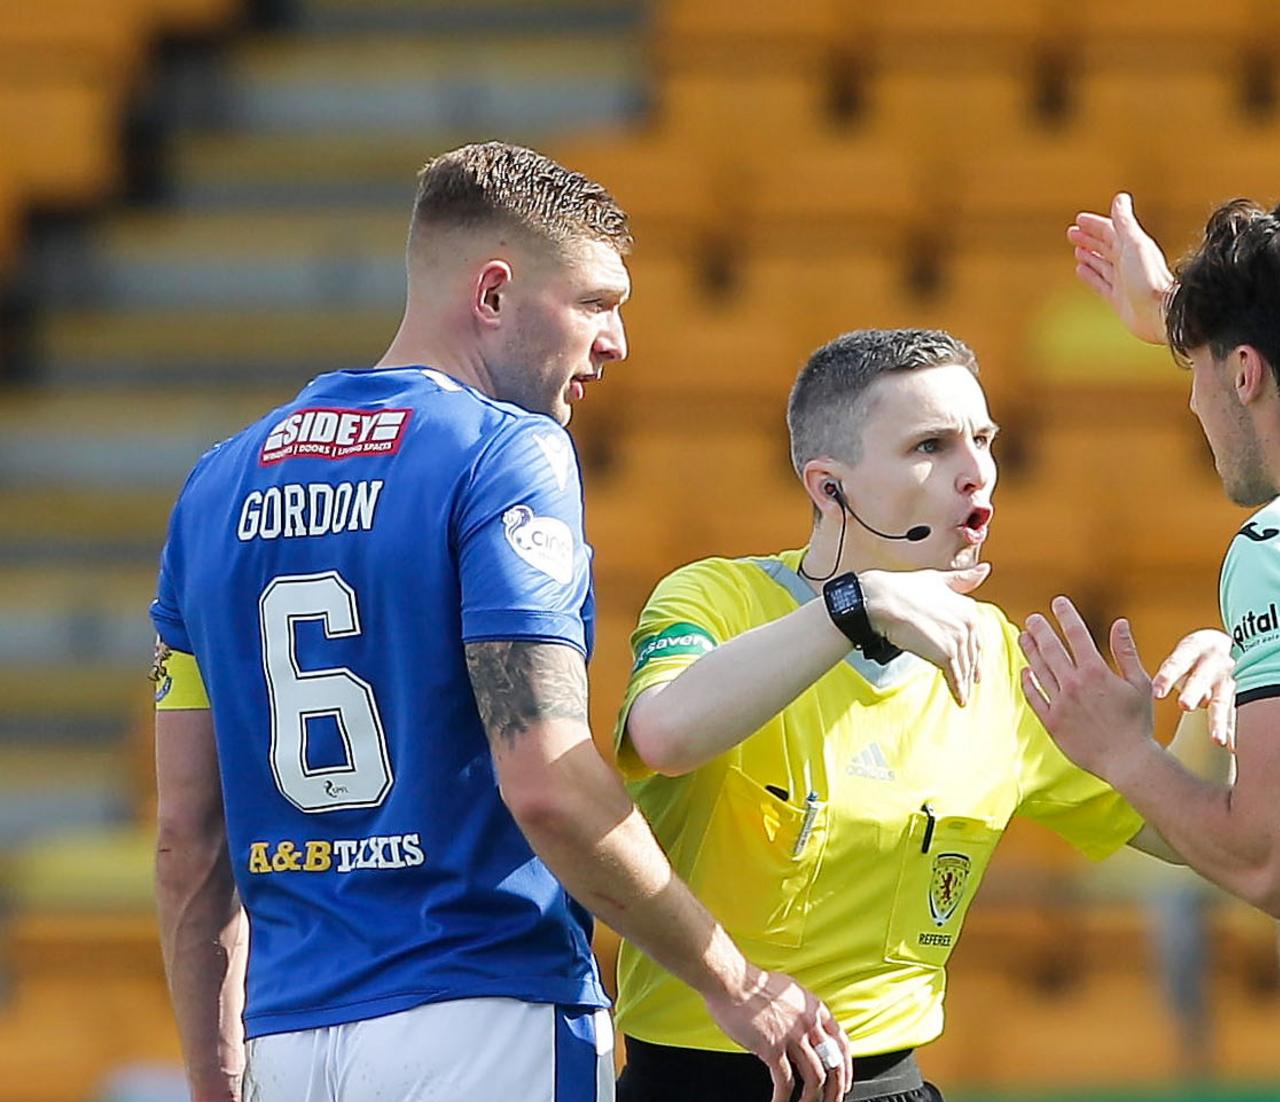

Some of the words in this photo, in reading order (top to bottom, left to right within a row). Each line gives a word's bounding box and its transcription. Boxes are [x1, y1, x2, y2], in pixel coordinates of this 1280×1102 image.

[283, 411, 378, 446] SIDEY
[238, 480, 385, 541] GORDON
[1232, 603, 1279, 653] pital
[259, 570, 394, 814] 6
[919, 933, 952, 947] REFEREE
